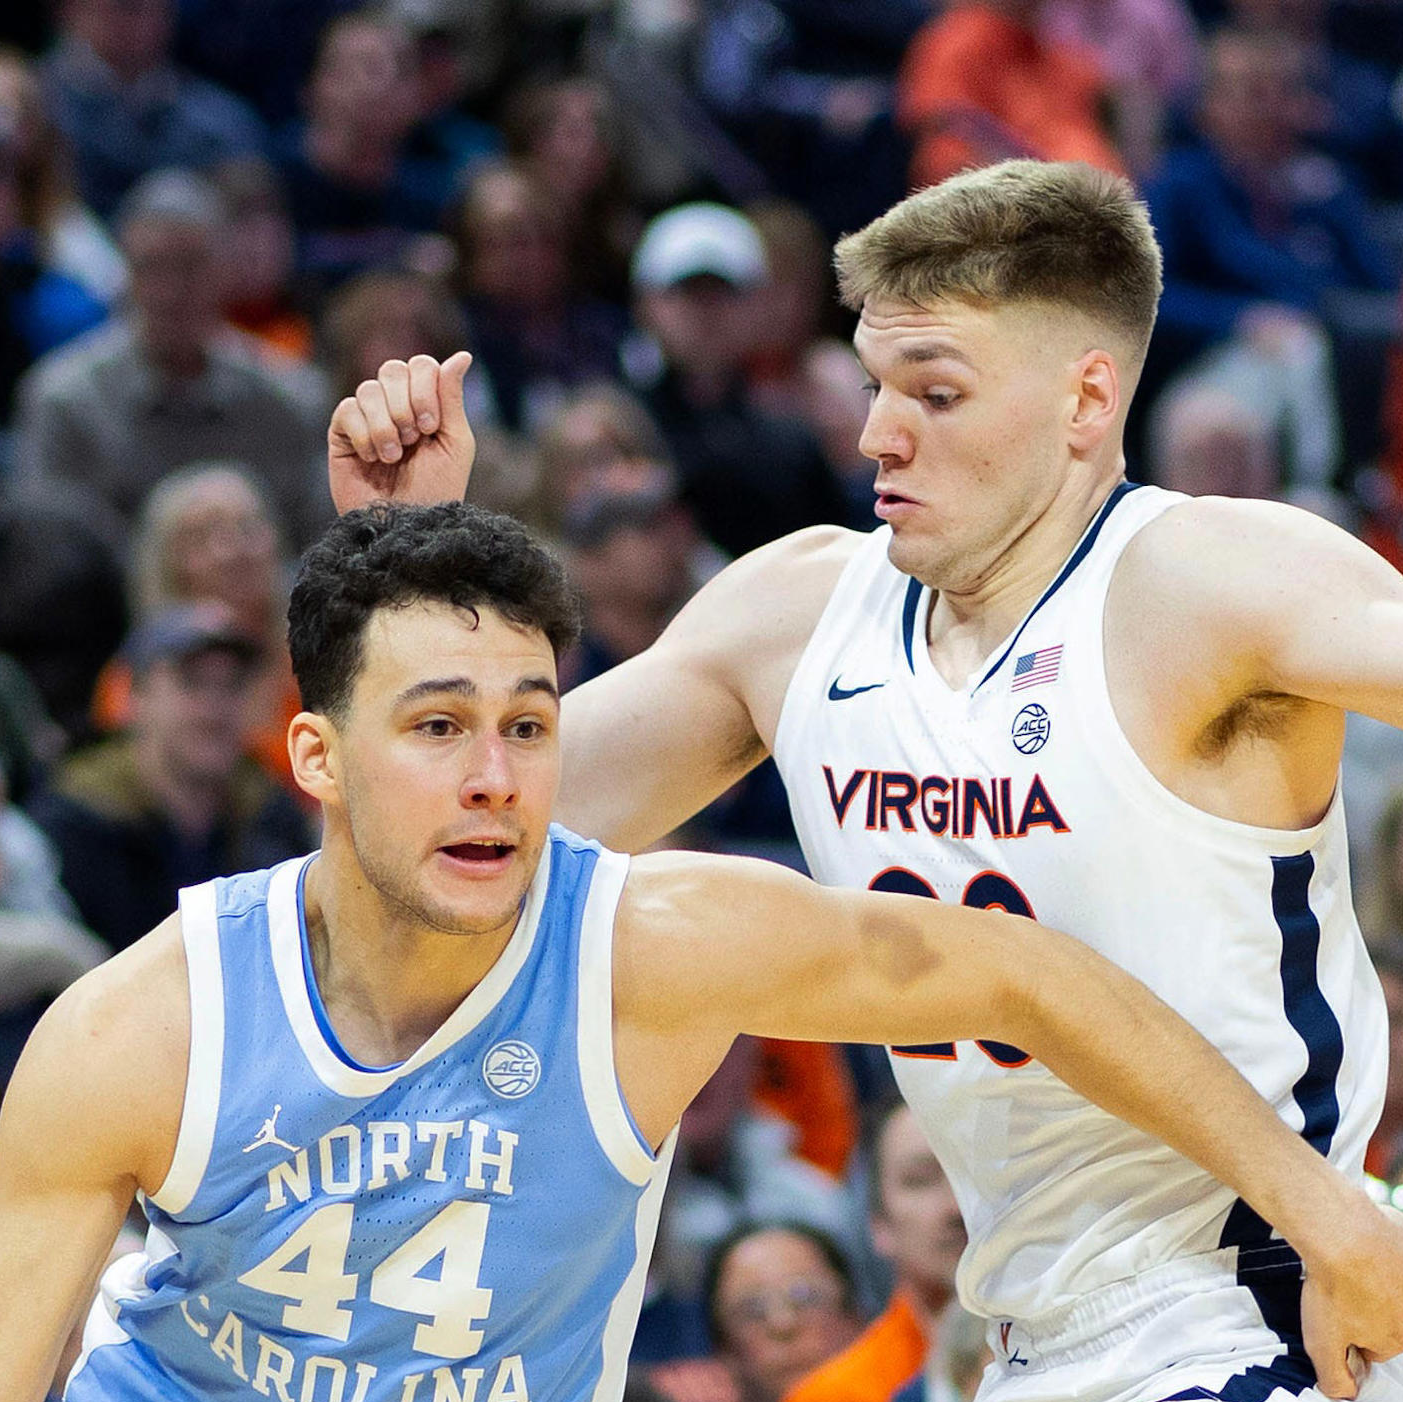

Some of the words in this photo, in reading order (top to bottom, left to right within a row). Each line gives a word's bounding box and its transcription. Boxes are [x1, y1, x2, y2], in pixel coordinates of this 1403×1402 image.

[1016, 717, 1048, 733] ACC
[822, 764, 1072, 839] VIRGINIA
[492, 1060, 535, 1072] ACC
[264, 1119, 519, 1212] NORTH
[236, 1200, 494, 1359] 44
